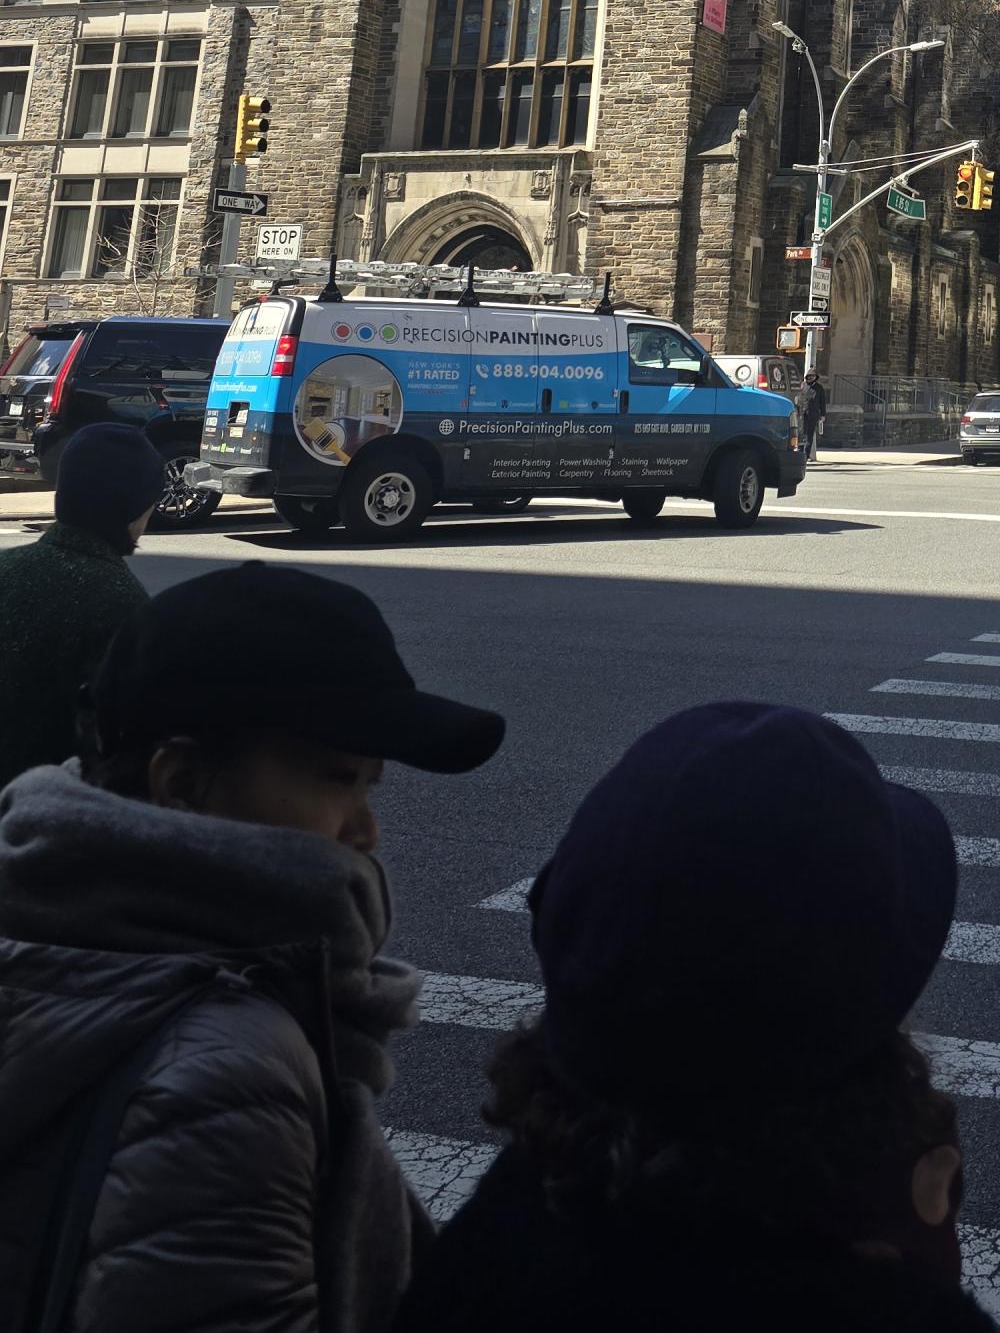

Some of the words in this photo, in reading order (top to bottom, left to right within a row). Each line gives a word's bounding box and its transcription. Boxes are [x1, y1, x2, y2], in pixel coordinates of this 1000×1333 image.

[222, 196, 239, 207] ONE
[244, 200, 261, 211] WAY
[261, 230, 297, 244] STOP
[262, 247, 279, 255] HERE
[283, 247, 294, 255] ON
[786, 250, 798, 258] Park
[402, 327, 604, 348] PRECISIONPAINTINGPLUS
[408, 369, 420, 380] #1
[424, 370, 460, 380] RATED
[493, 364, 604, 380] 888.904.0096
[459, 420, 613, 437] PrecisionPaintingPlus.com
[493, 459, 520, 467] Interior
[522, 459, 551, 469] Painting
[559, 458, 581, 466] Power
[582, 458, 612, 468] Washing
[621, 458, 649, 468] Staining
[656, 458, 689, 467] Wallpaper
[491, 470, 520, 478] Exterior
[521, 470, 551, 480] Painting
[559, 470, 594, 480] Carpentry
[641, 468, 674, 476] Sheetrock
